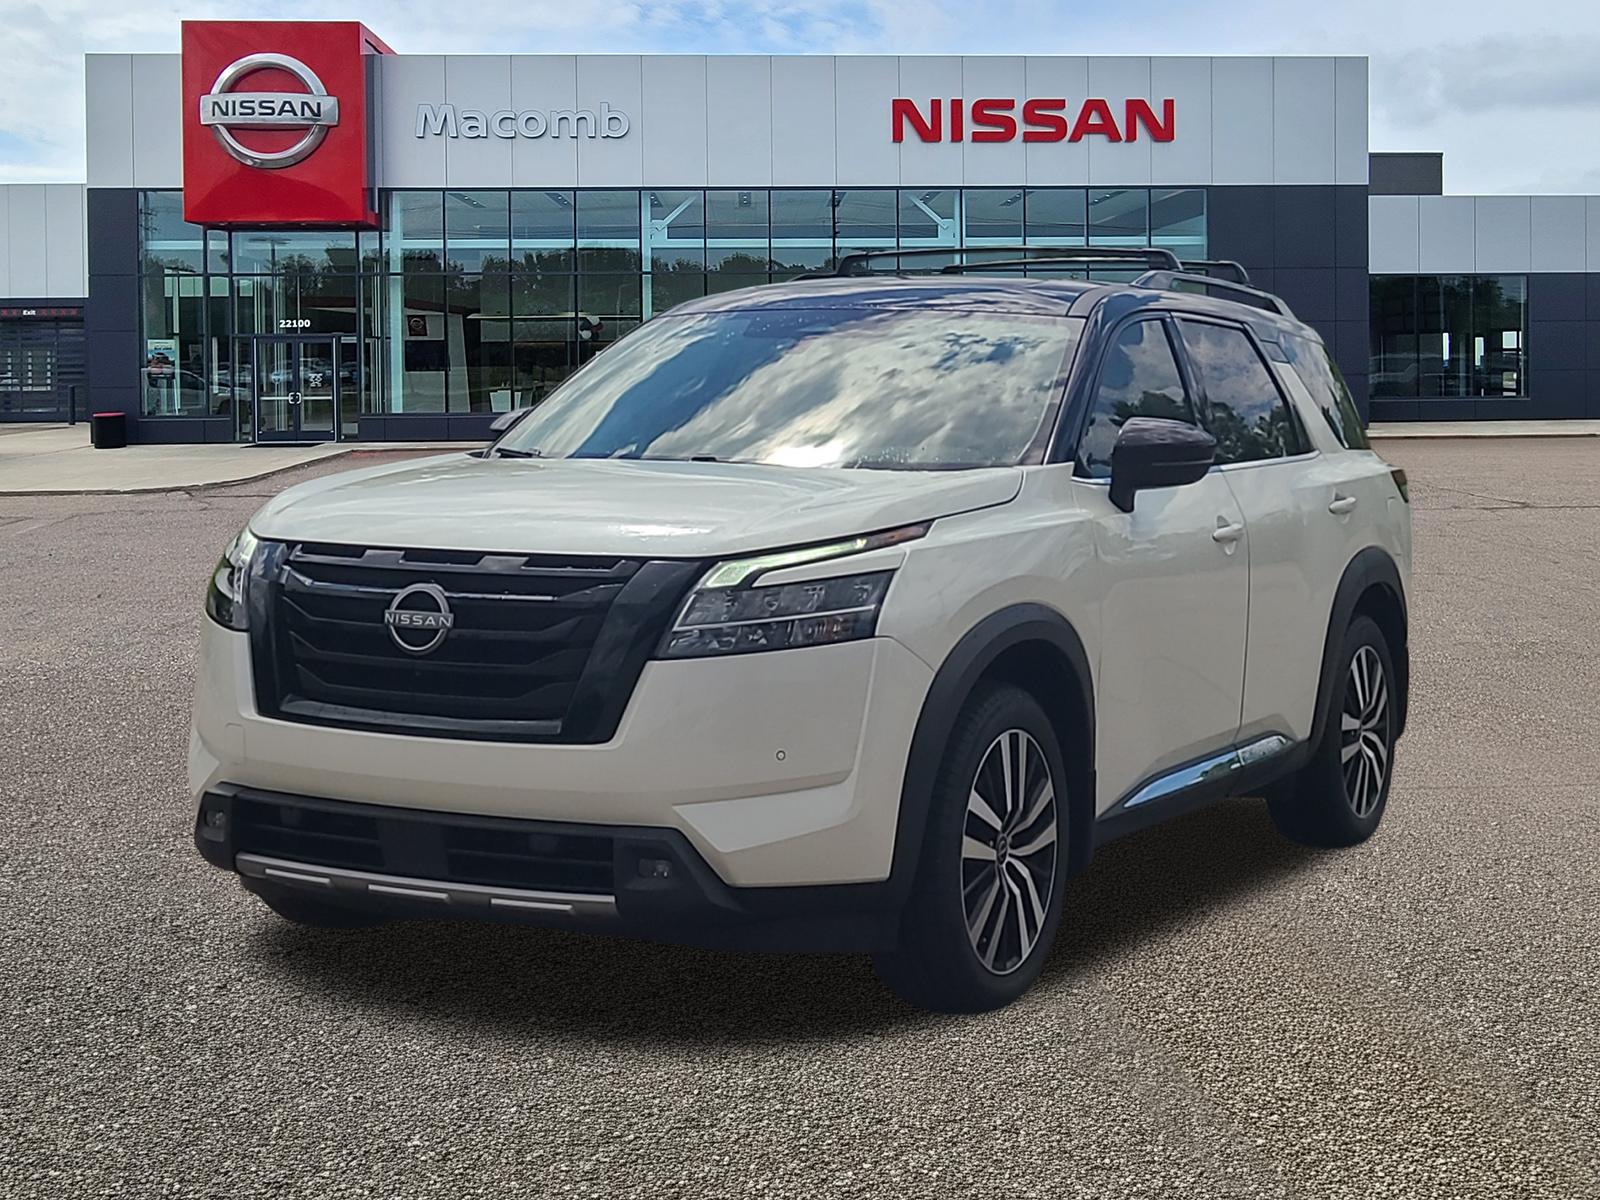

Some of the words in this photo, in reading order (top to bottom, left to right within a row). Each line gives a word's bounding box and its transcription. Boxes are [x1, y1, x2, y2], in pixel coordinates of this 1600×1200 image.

[212, 100, 322, 118] NISSAN
[415, 102, 630, 139] Macomb
[892, 98, 1175, 143] NISSAN
[279, 319, 311, 328] 22100
[384, 612, 452, 628] NISSAN
